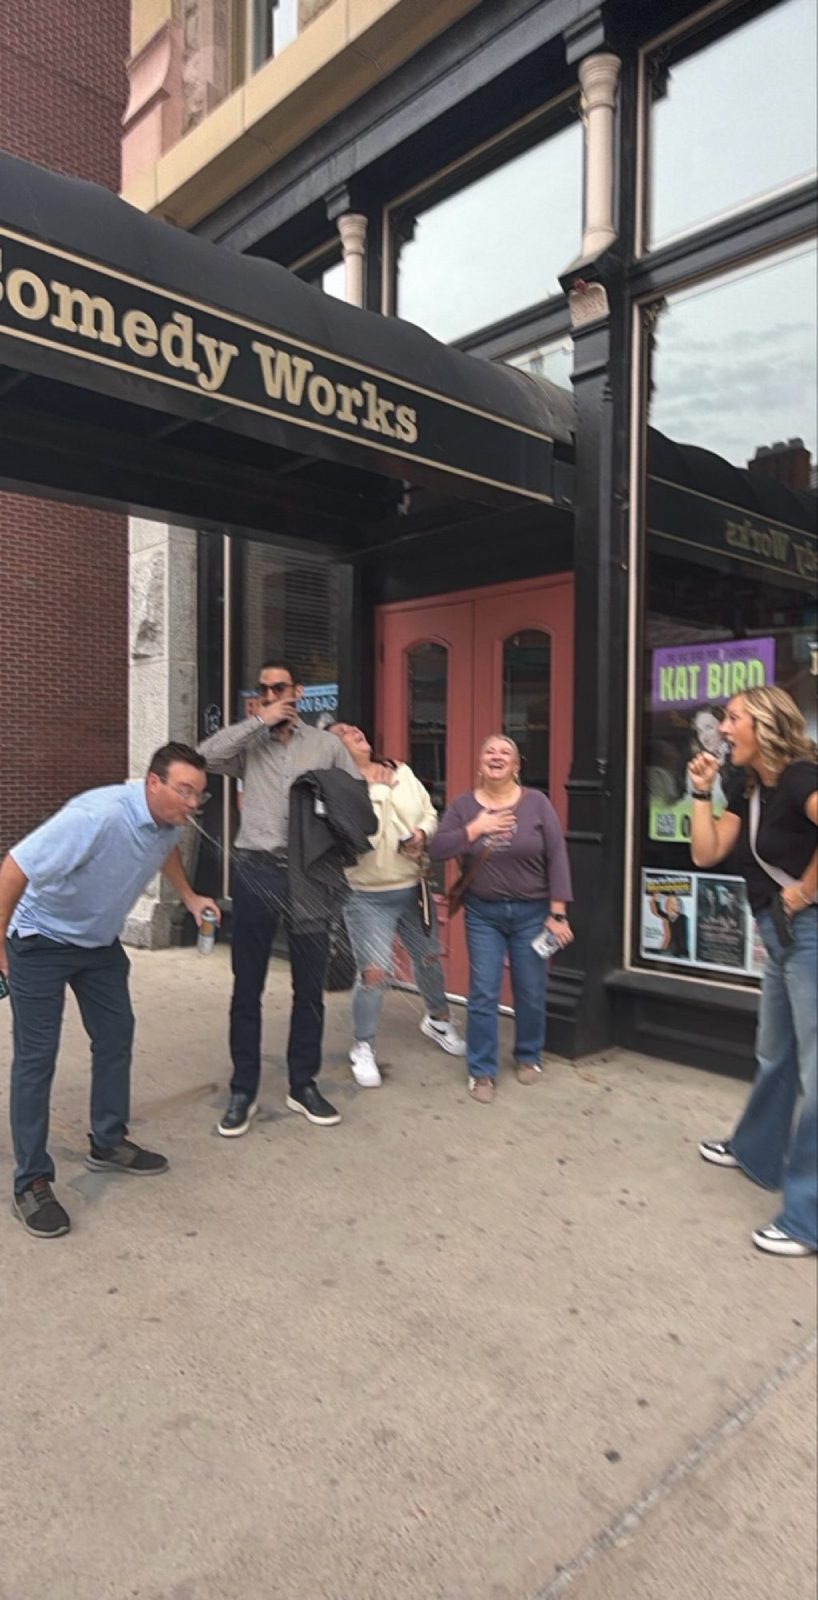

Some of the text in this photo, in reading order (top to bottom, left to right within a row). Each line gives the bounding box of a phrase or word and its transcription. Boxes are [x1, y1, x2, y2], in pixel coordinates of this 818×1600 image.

[0, 247, 418, 444] omedy Works
[660, 664, 701, 701] KAT
[707, 658, 765, 699] BIRD
